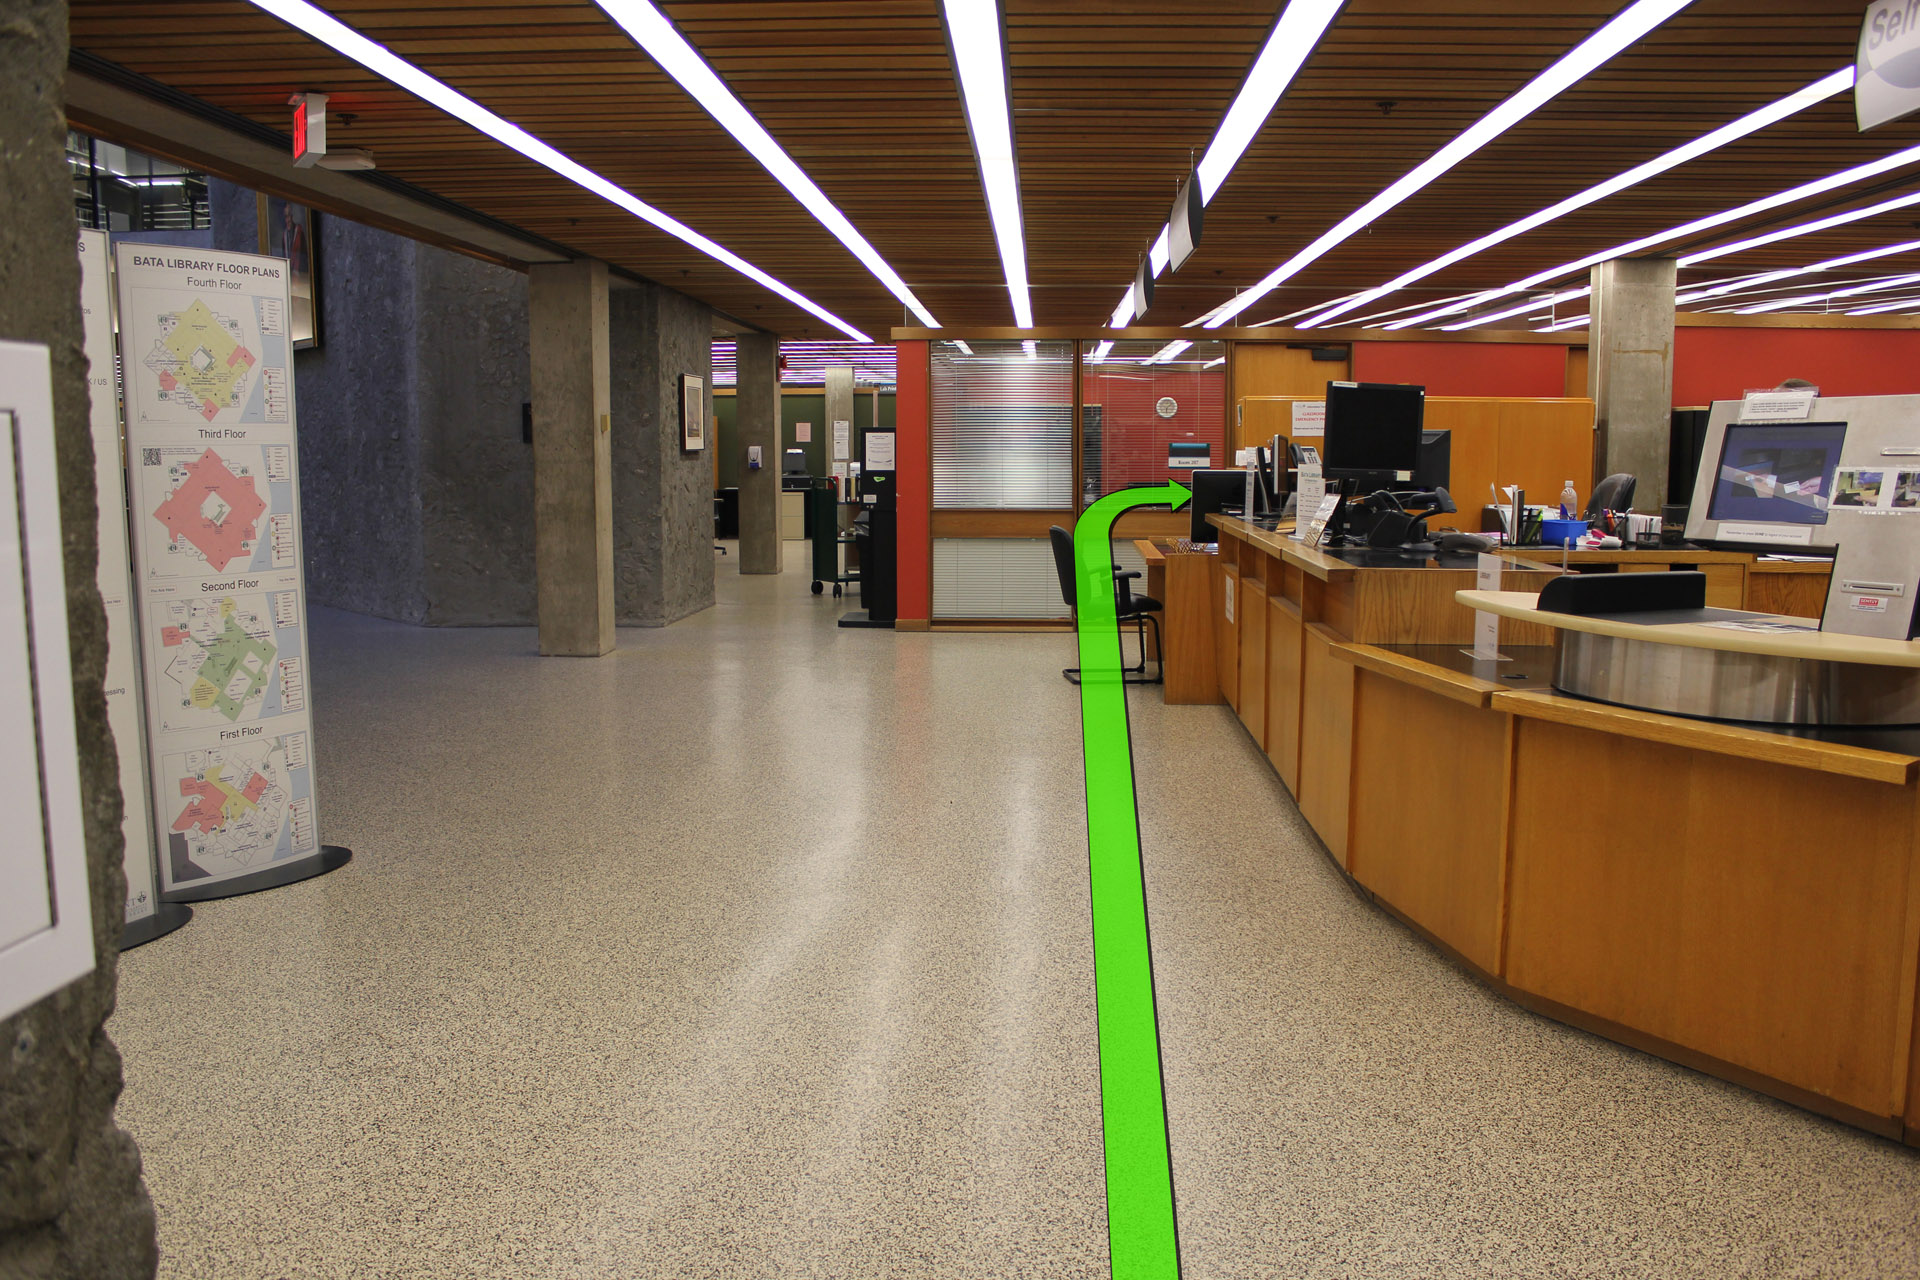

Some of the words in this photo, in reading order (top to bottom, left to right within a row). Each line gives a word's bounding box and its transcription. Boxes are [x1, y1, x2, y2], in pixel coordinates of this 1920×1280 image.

[133, 256, 164, 268] BATA
[167, 258, 214, 271] LIBRARY
[216, 263, 250, 275] FLOOR
[252, 266, 280, 279] PLANS
[187, 276, 217, 288] Fourth
[219, 279, 242, 290] Floor
[198, 429, 222, 439] Third
[224, 429, 247, 439] Floor
[201, 580, 236, 592] Second
[238, 578, 260, 589] Floor
[219, 730, 240, 741] First
[241, 726, 263, 738] Floor
